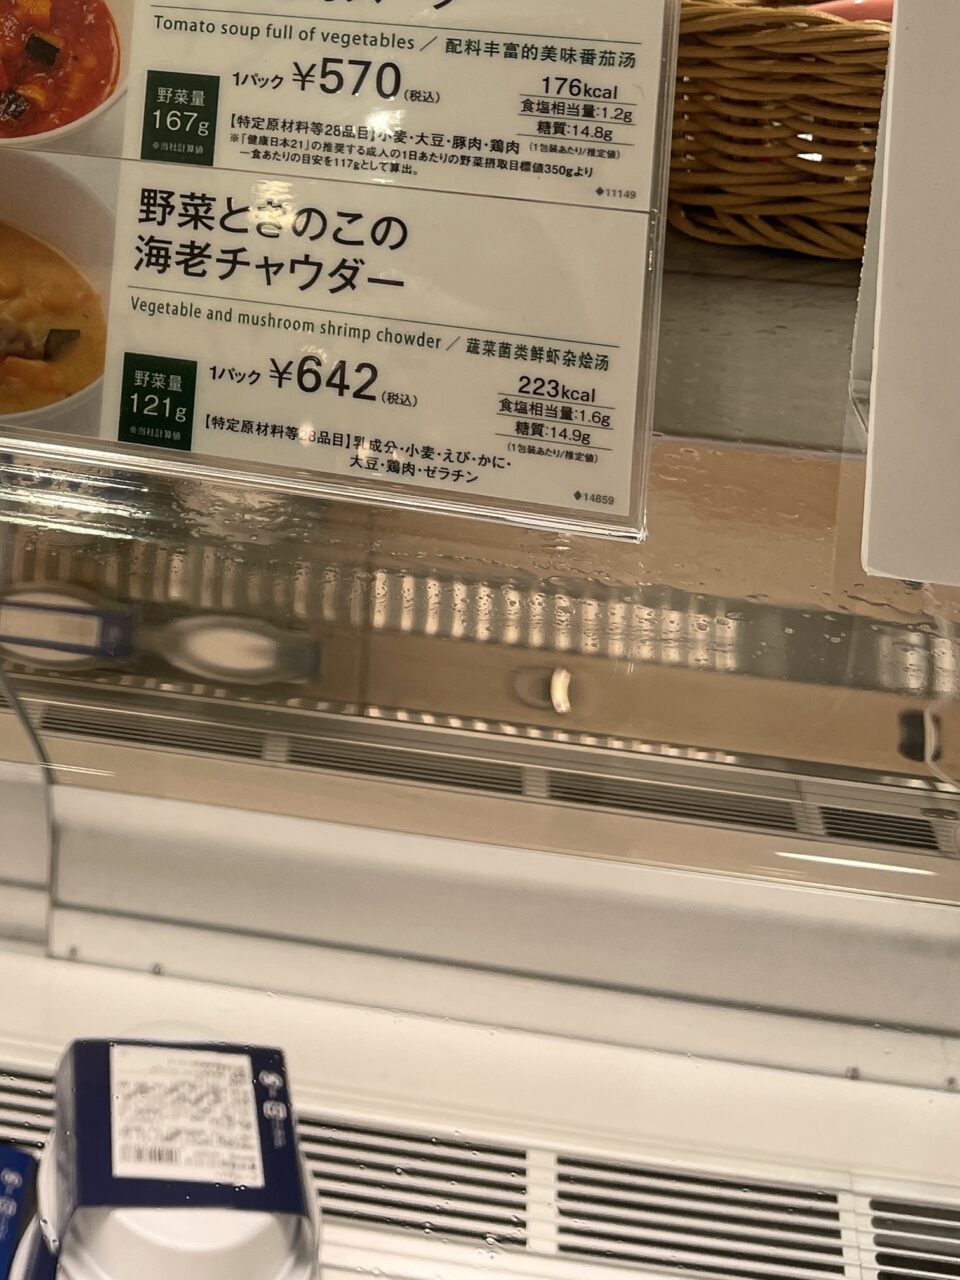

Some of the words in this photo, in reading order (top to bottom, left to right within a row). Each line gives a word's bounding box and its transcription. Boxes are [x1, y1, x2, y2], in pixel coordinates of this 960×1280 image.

[153, 14, 216, 34] Tomato
[219, 23, 262, 41] soup
[265, 23, 293, 41] full
[297, 26, 318, 42] of
[320, 30, 415, 51] vegetables
[444, 36, 637, 70] 配料丰富的美味番茄汤
[231, 70, 285, 91] 1パック
[540, 75, 618, 101] 176kcal
[156, 86, 207, 108] 野菜量
[151, 108, 211, 138] 167g
[137, 187, 408, 251] 野菜ときのこの
[133, 234, 405, 295] 海老チャウダー
[130, 295, 202, 320] Vegetable
[205, 306, 234, 323] and
[237, 310, 315, 333] mushroom
[319, 319, 372, 344] shrimp
[375, 326, 442, 350] chowder
[133, 368, 184, 394] 野菜量
[208, 364, 262, 386] 1パック
[517, 374, 596, 403] 223kcal
[129, 391, 187, 424] 121g
